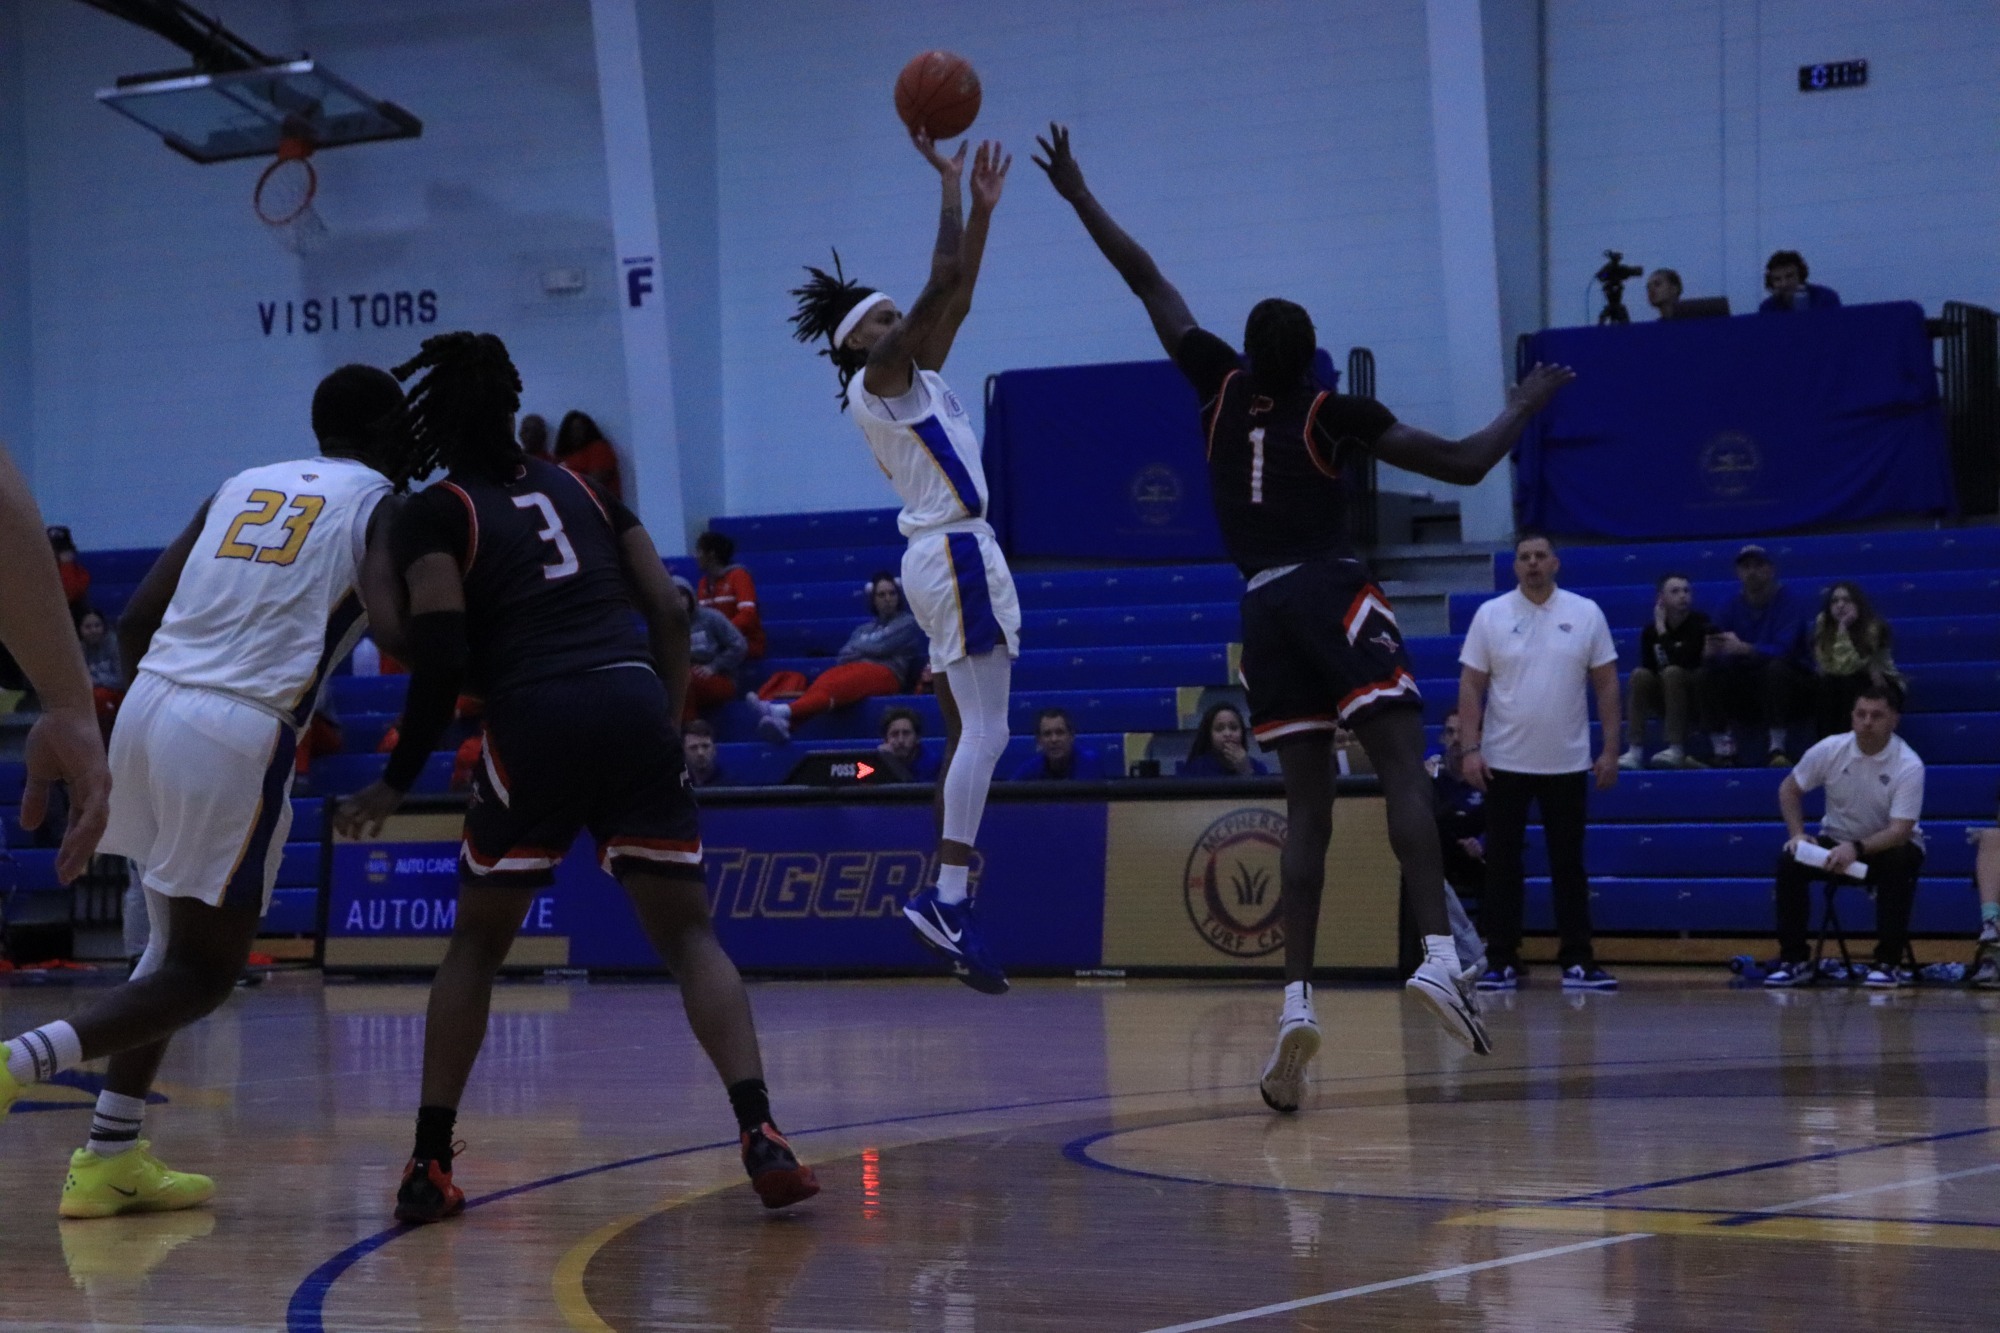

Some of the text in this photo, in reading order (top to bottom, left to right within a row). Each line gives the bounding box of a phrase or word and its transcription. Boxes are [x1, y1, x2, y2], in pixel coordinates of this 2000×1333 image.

[628, 267, 653, 307] F
[258, 289, 437, 336] VISITORS
[1248, 427, 1265, 503] 1
[215, 489, 326, 567] 23
[511, 492, 580, 580] 3
[395, 858, 424, 874] AUTO
[345, 897, 554, 930] AUTOME
[1257, 922, 1286, 949] CA
